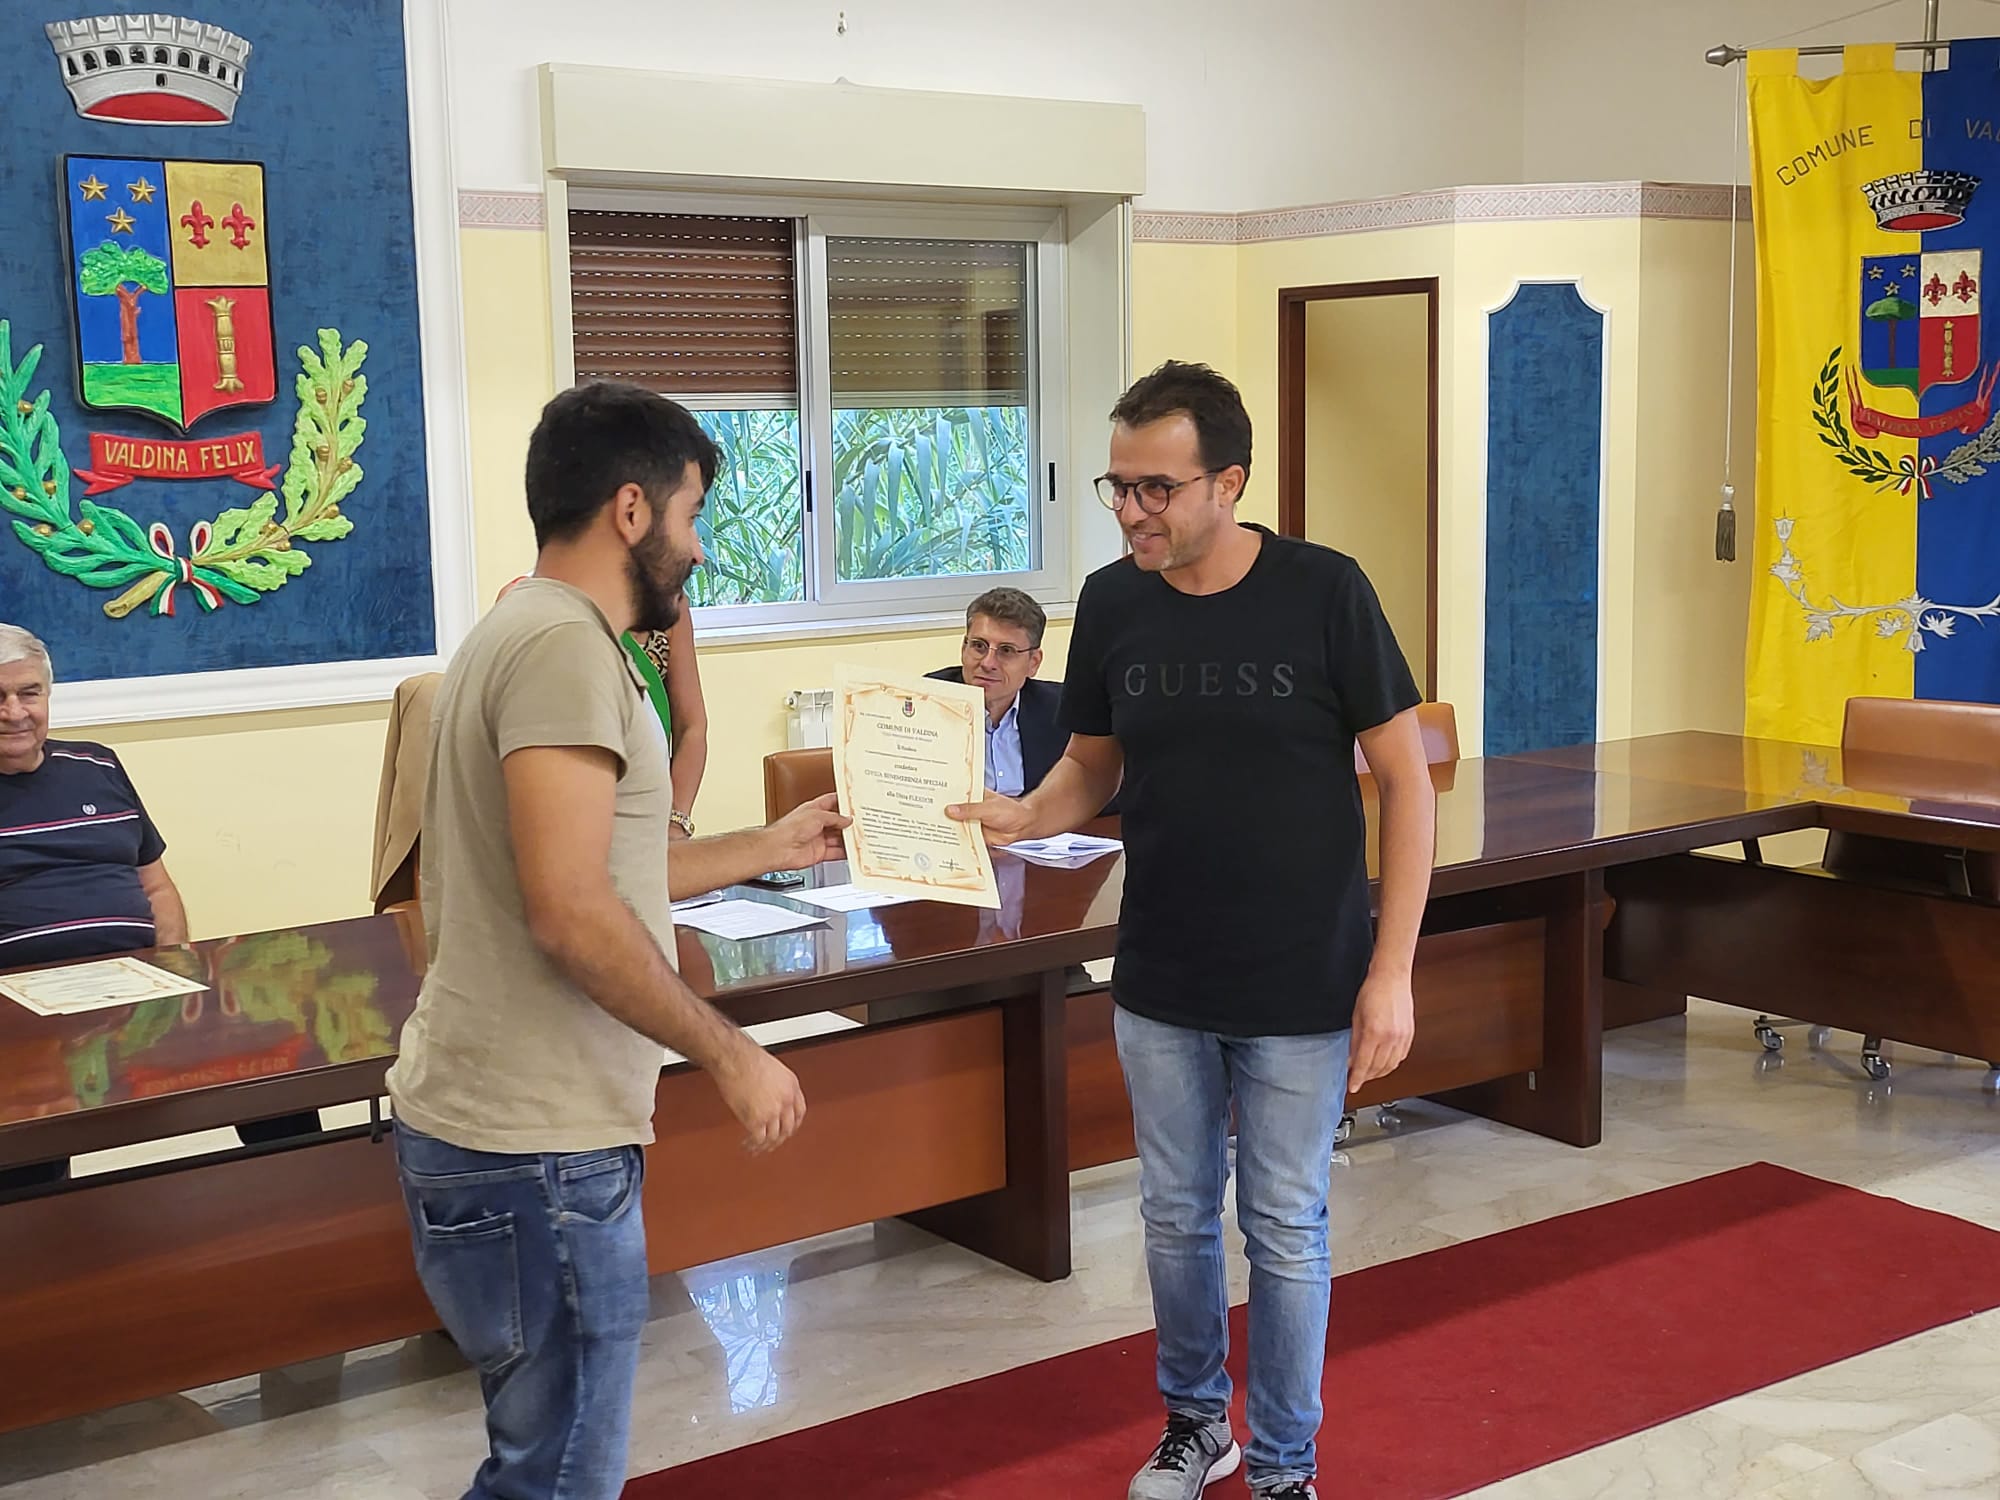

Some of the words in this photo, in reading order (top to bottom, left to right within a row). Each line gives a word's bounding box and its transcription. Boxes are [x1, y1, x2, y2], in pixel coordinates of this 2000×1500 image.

[1776, 125, 1874, 186] COMUNE
[1908, 118, 1931, 140] DI
[104, 440, 189, 473] VALDINA
[199, 440, 256, 472] FELIX
[1123, 662, 1295, 697] GUESS
